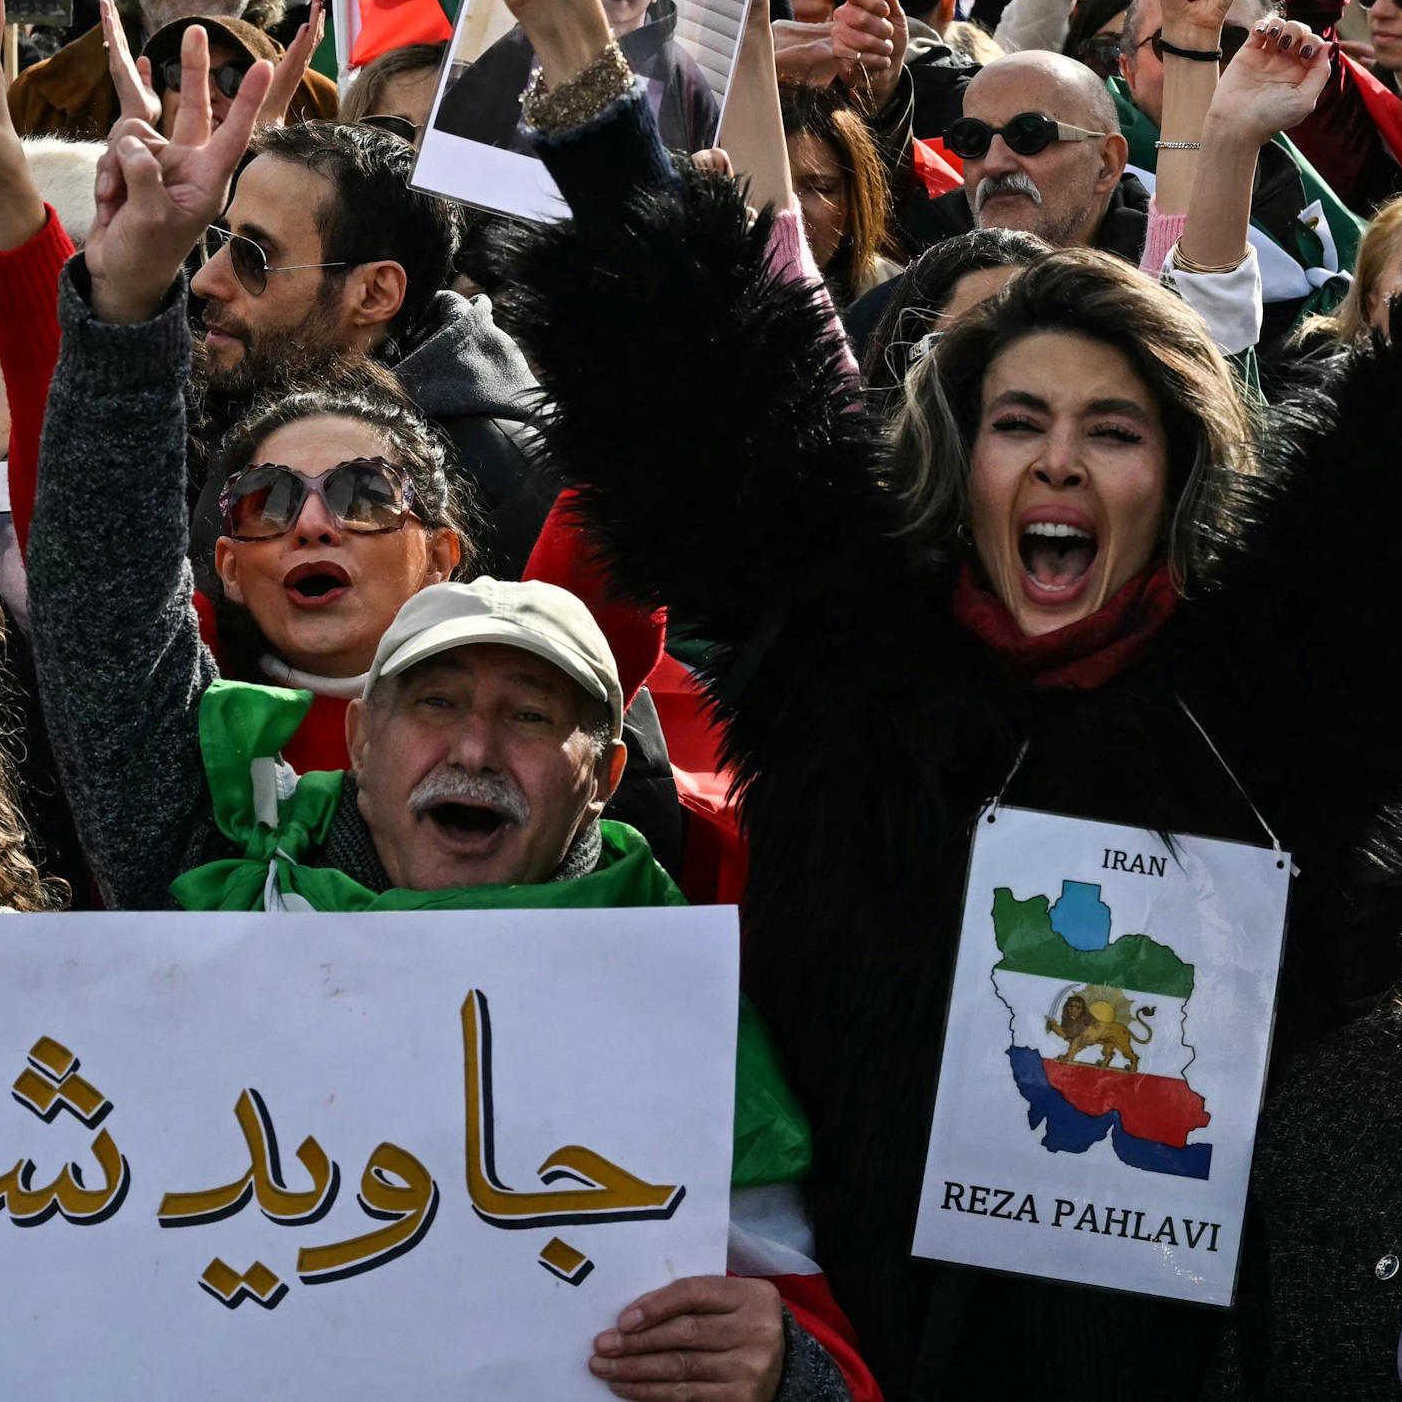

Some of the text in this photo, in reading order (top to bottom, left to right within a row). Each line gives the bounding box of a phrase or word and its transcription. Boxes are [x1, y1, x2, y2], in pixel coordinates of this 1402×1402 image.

[1101, 848, 1168, 878] IRAN
[156, 988, 686, 1310] جاوید
[940, 1181, 1222, 1253] REZA PAHLAVI
